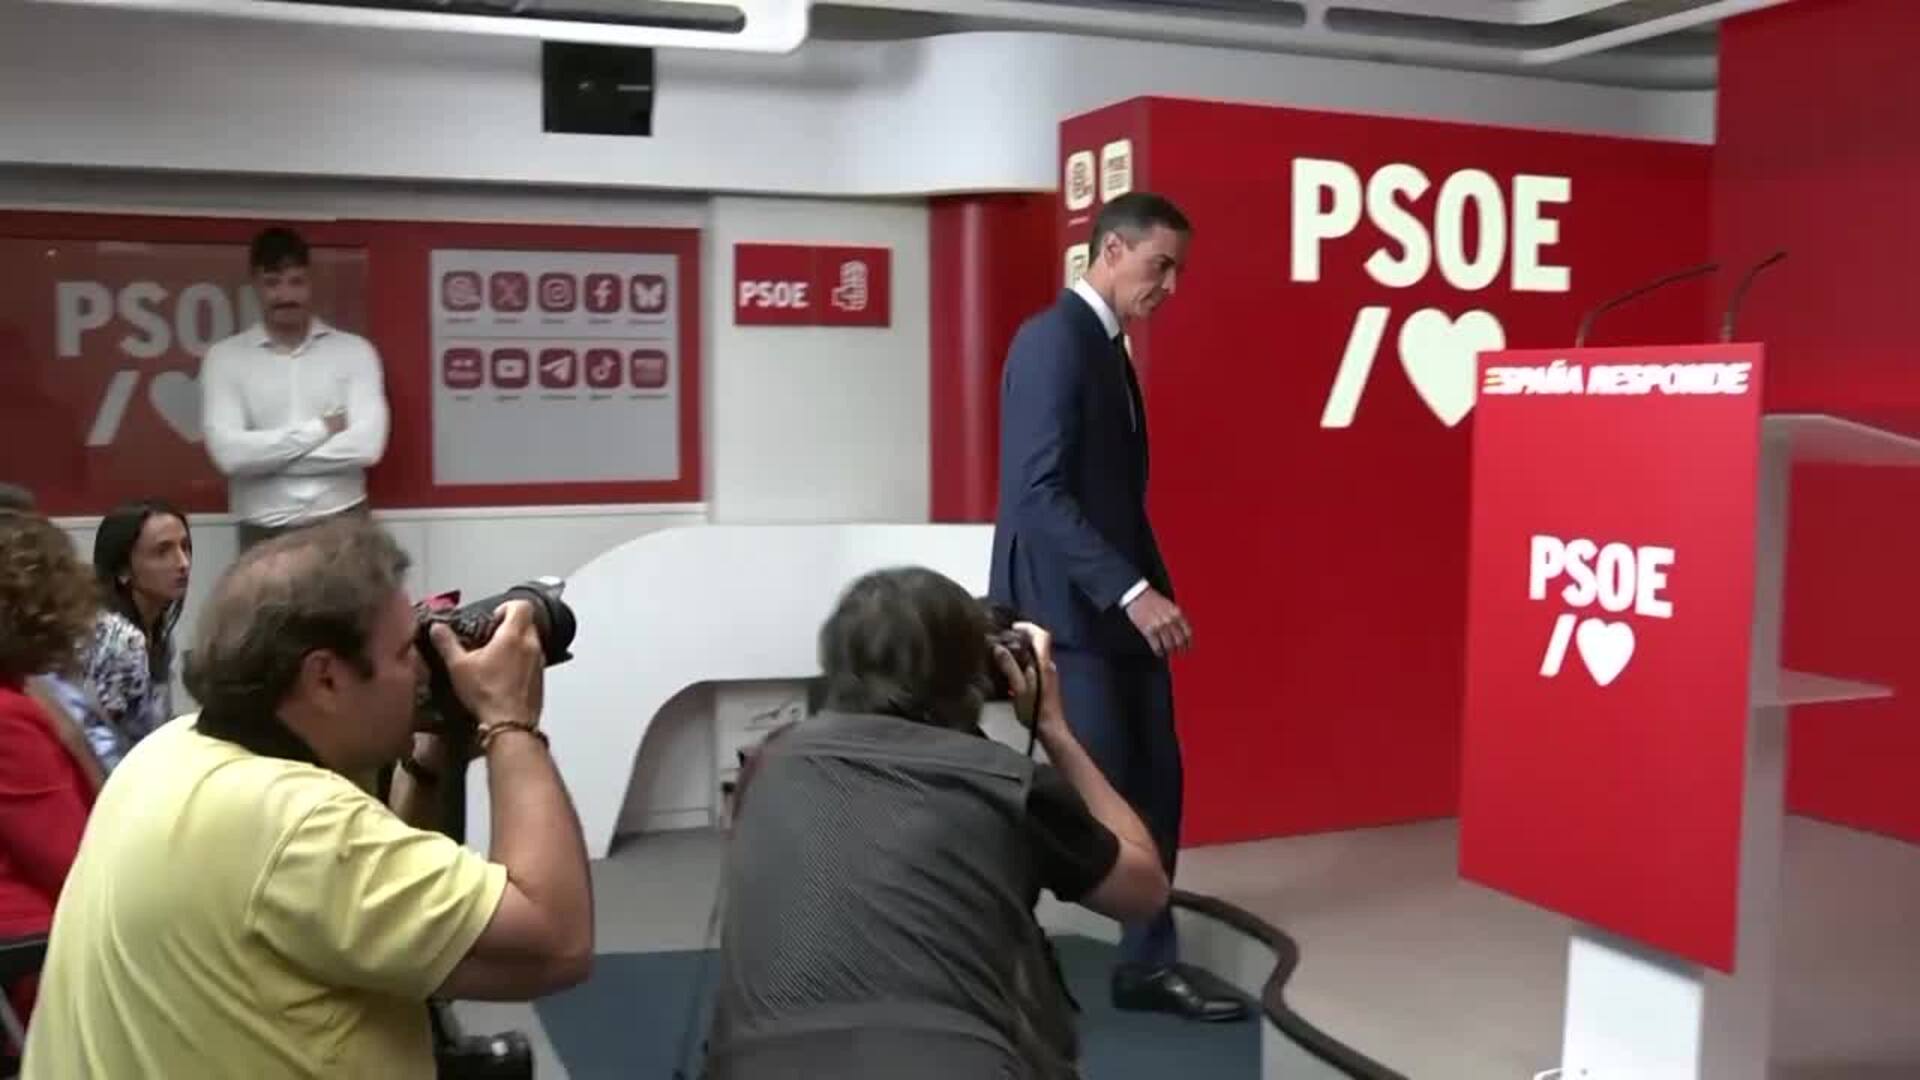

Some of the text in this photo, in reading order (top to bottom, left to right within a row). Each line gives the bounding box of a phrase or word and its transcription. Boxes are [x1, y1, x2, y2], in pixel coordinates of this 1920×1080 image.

[1291, 158, 1572, 292] PSOE
[739, 280, 810, 308] PSOE
[1586, 361, 1753, 395] RESPONDE
[1529, 534, 1676, 619] PSOE
